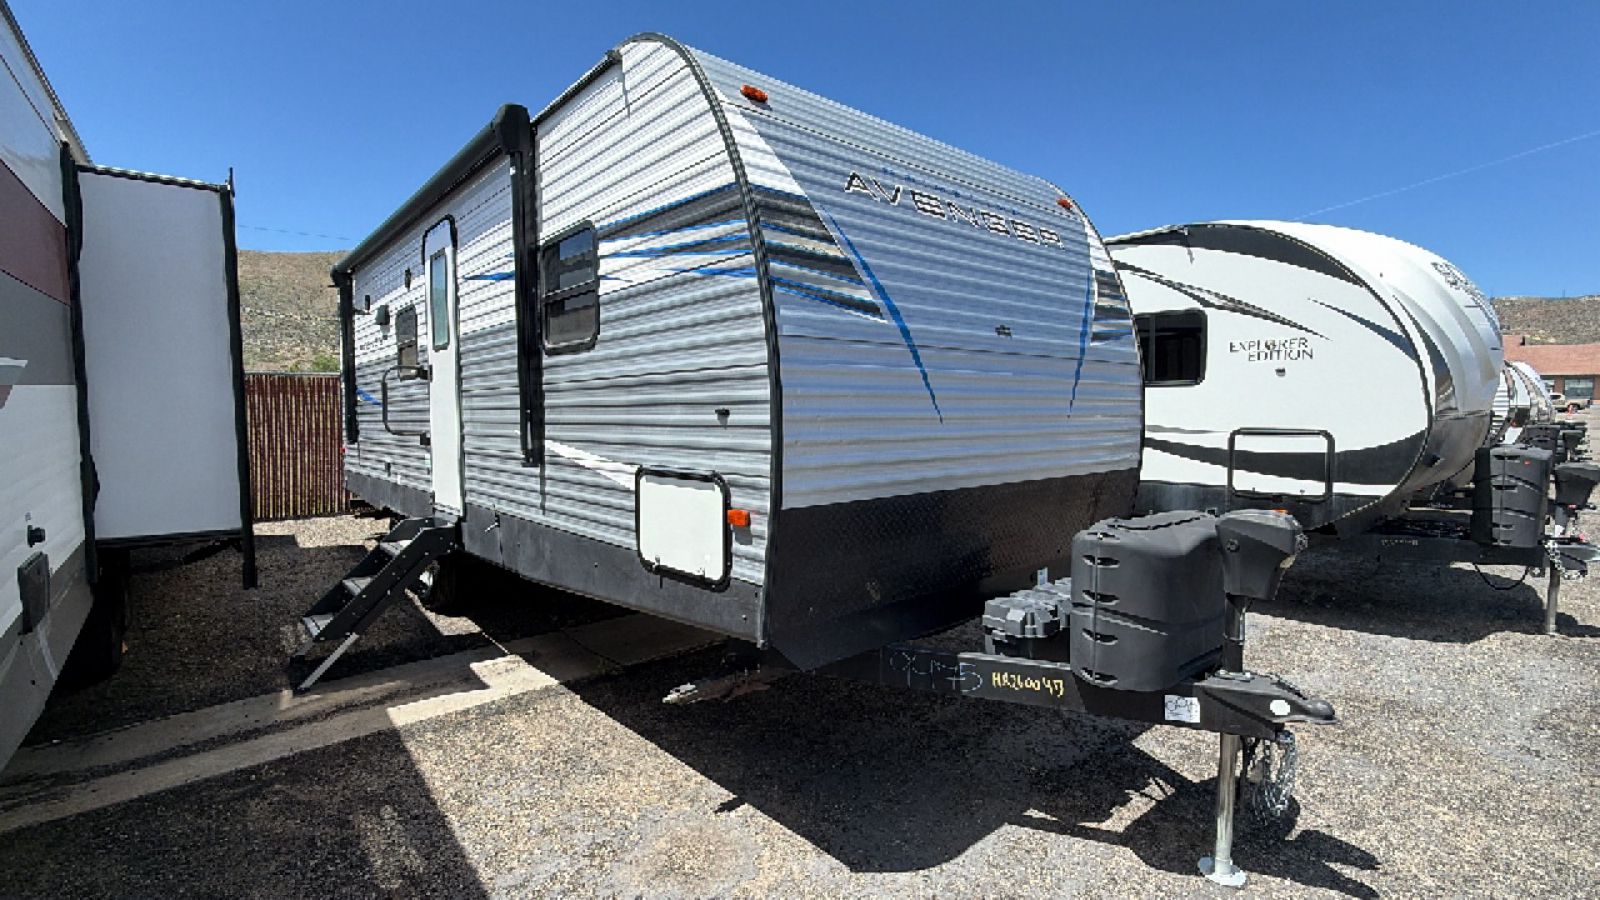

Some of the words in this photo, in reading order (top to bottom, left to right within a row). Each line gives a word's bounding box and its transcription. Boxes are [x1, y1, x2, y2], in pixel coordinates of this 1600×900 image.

[844, 170, 1065, 251] AVENGER
[1229, 337, 1309, 353] EXPLORER
[1248, 349, 1314, 362] EDITION
